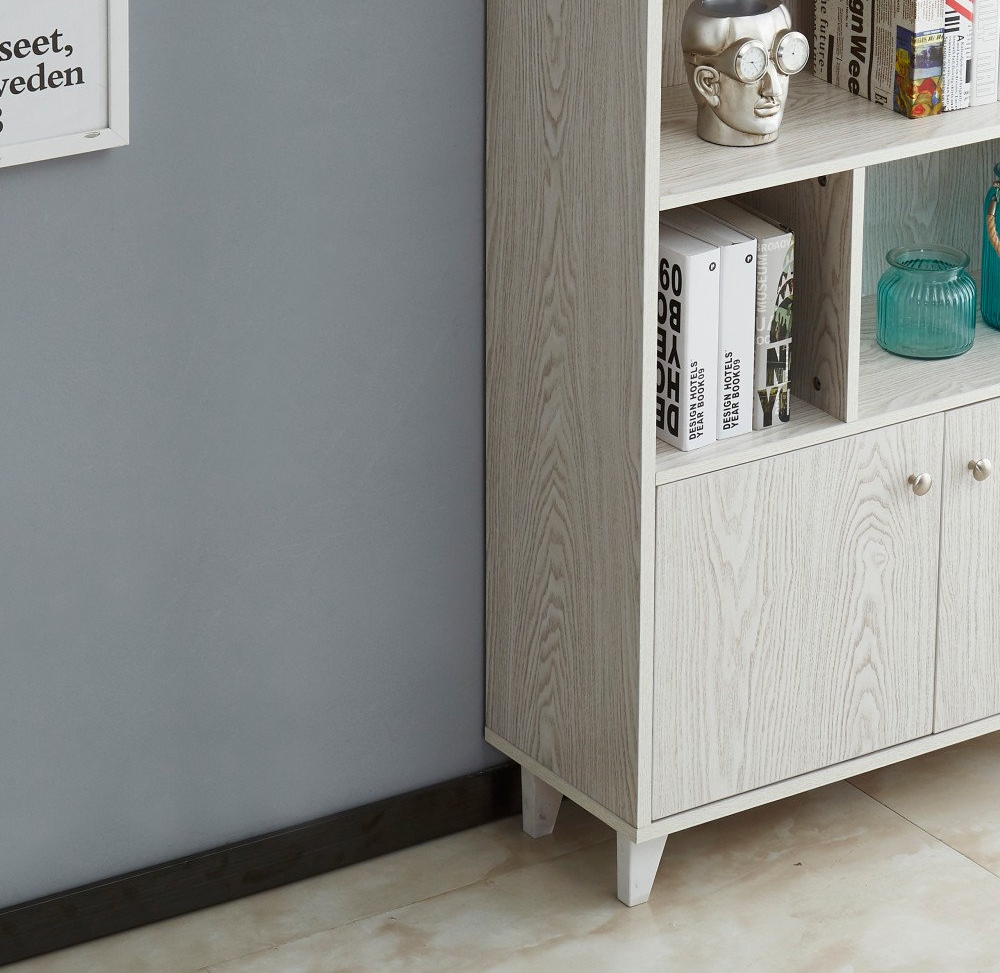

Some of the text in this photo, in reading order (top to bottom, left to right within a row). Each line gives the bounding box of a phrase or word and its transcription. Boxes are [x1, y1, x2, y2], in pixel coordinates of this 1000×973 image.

[757, 254, 768, 313] MUSEUM
[689, 361, 698, 440] DESIGN HOTELS
[723, 351, 733, 430] DESIGN HOTELS
[731, 402, 740, 429] YEAR
